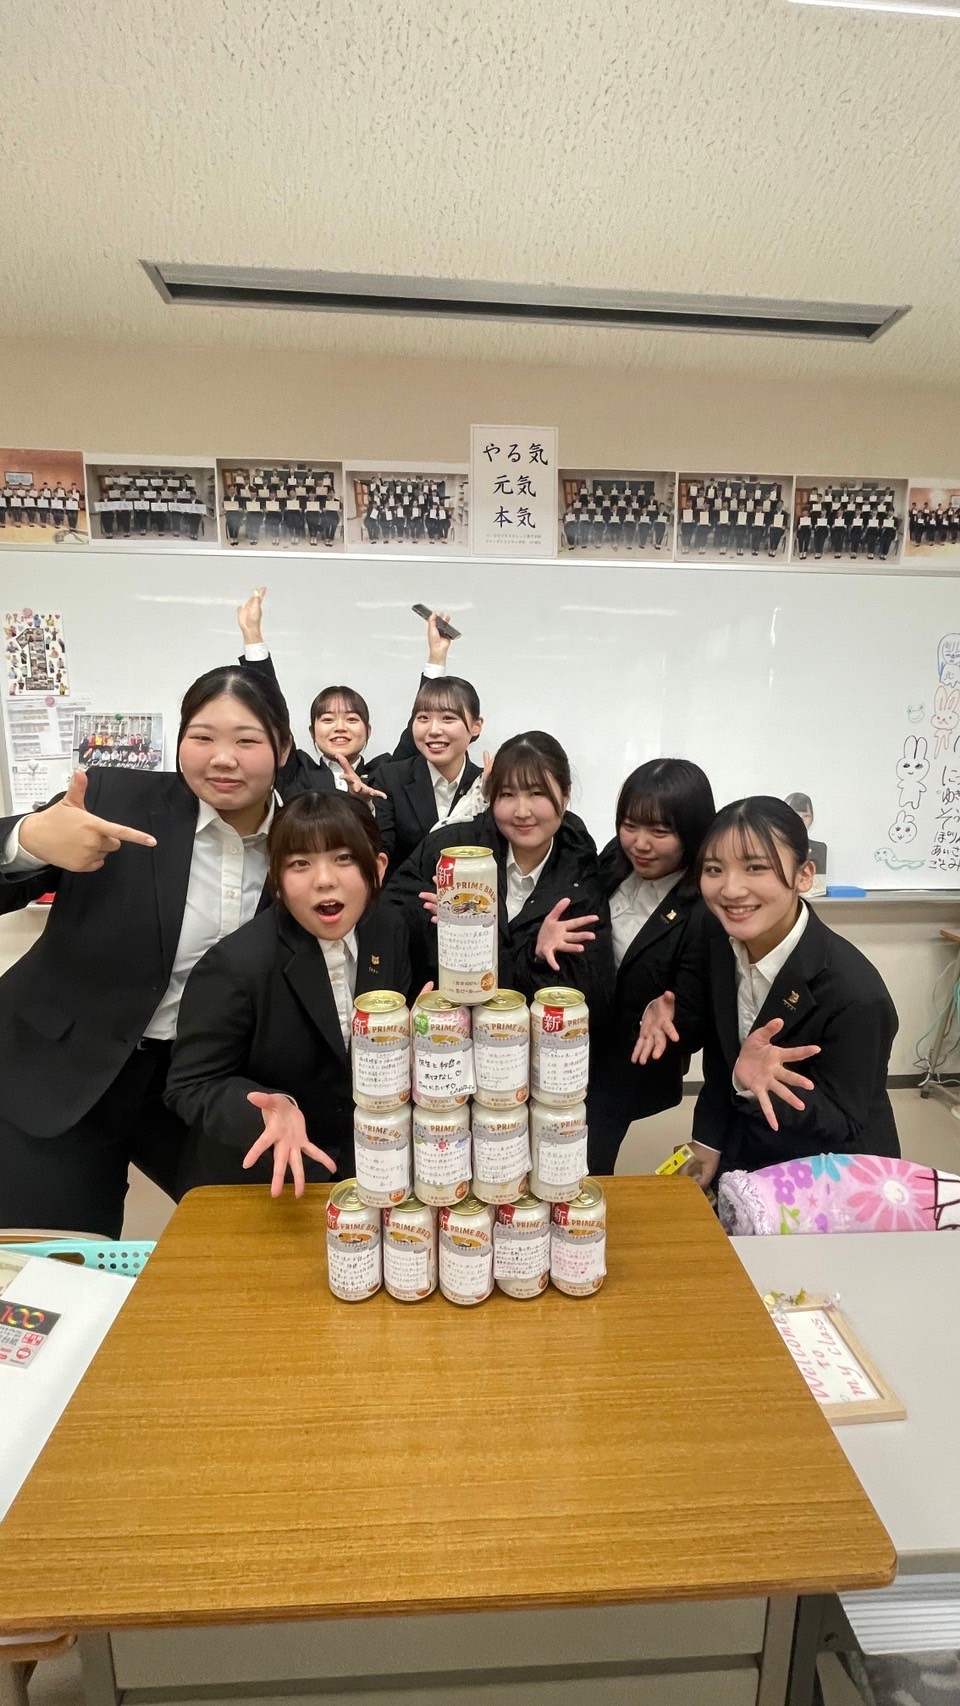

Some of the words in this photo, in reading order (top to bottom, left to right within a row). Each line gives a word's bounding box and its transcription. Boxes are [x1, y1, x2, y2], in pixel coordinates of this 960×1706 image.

[482, 442, 549, 466] やる気
[492, 474, 537, 498] 元気
[492, 505, 537, 529] 本気
[438, 864, 453, 886] 新
[456, 881, 484, 891] PRIME
[430, 1023, 457, 1031] PRIME
[491, 1023, 516, 1031] PRIME
[543, 1013, 562, 1032] 新
[372, 1025, 398, 1033] PRIME
[363, 1124, 388, 1135] PRIME
[430, 1125, 456, 1133] PRIME
[341, 1223, 366, 1231] PRIME
[391, 1221, 416, 1232] PRIME
[516, 1221, 541, 1229] PRIME
[571, 1219, 596, 1227] PRIME
[450, 1225, 475, 1236] PRIME
[810, 1316, 843, 1357] class
[773, 1315, 830, 1400] Welcome
[811, 1348, 832, 1370] to
[836, 1364, 867, 1397] my
